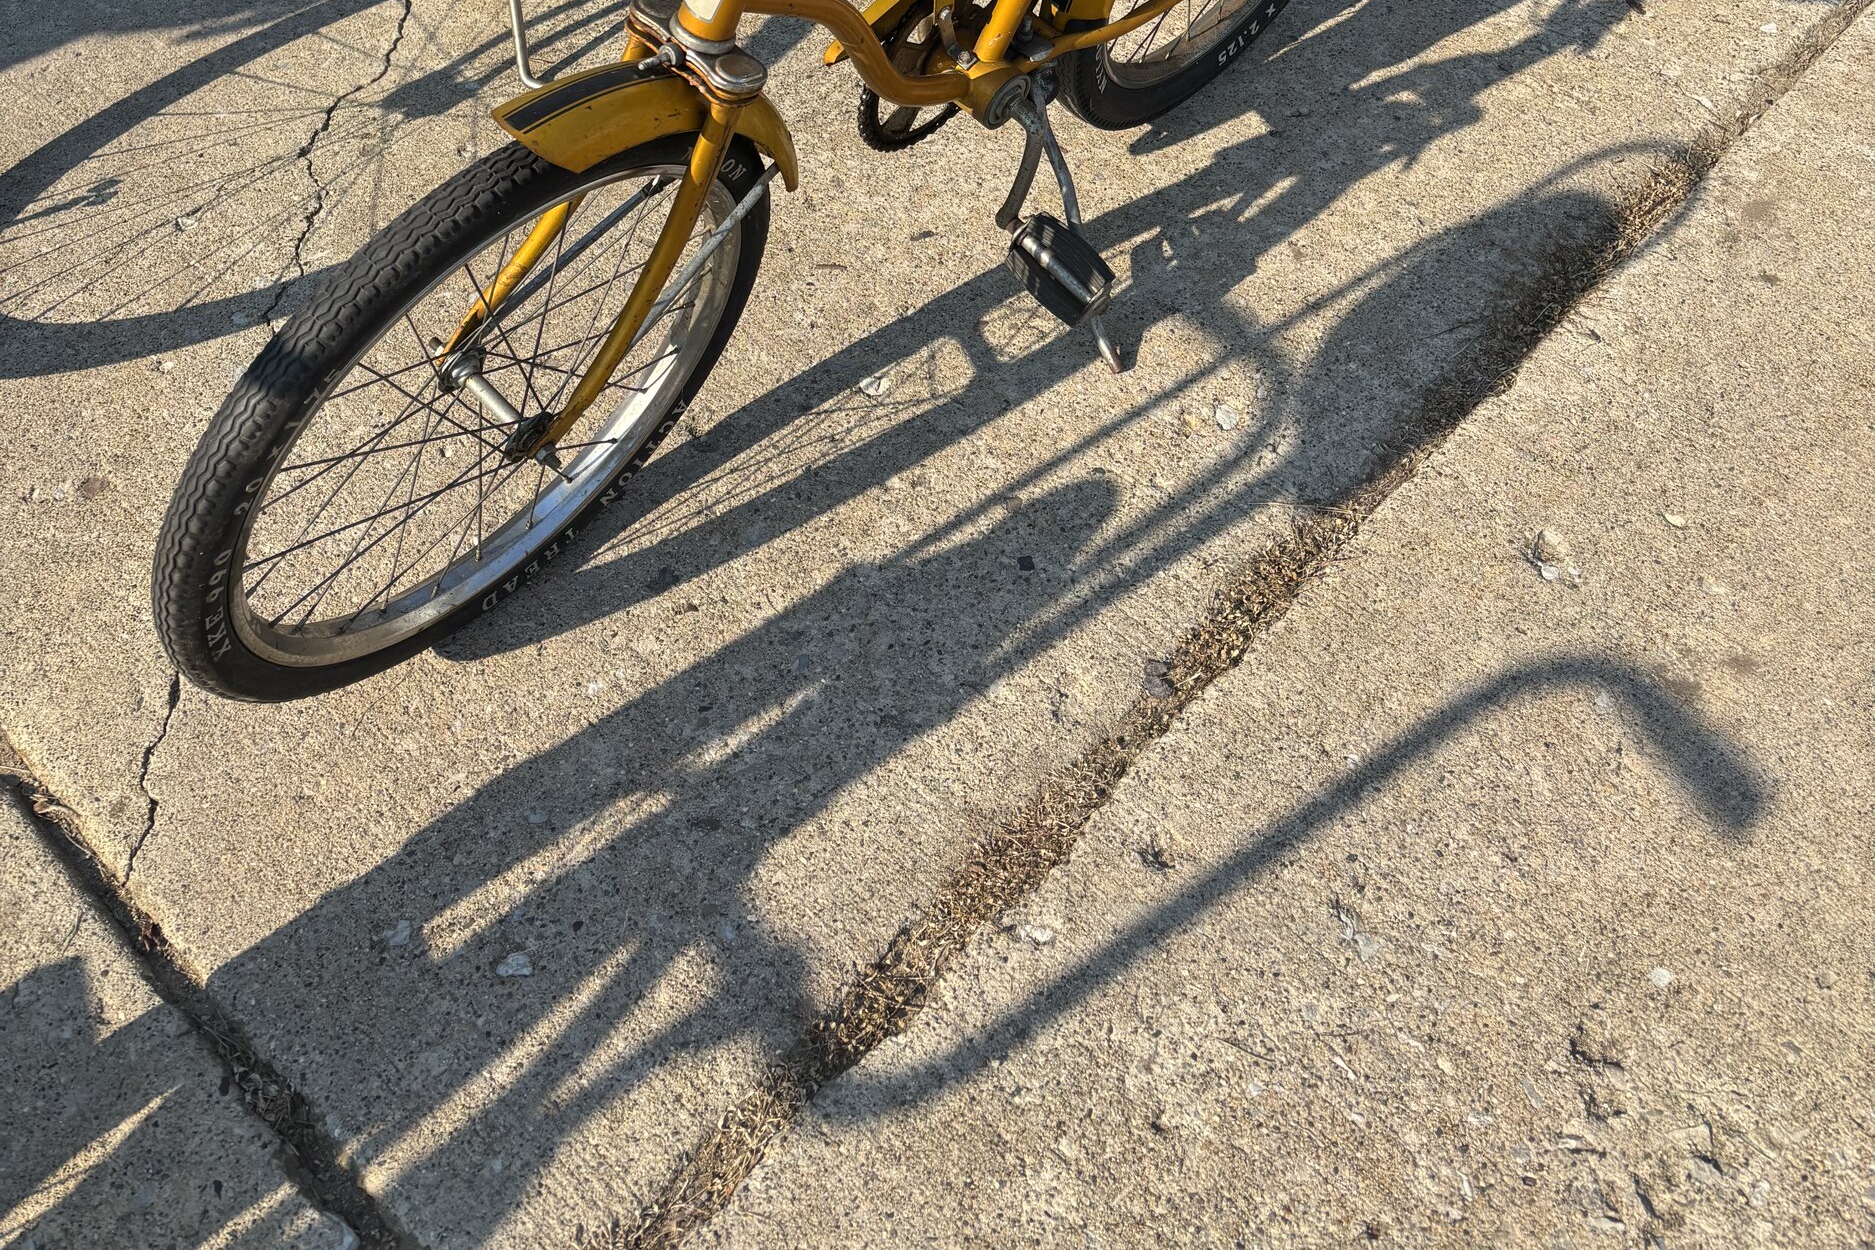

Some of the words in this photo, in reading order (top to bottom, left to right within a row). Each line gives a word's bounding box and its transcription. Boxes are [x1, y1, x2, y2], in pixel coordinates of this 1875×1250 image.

[1217, 19, 1261, 66] 2.125
[599, 402, 687, 508] ACTION
[233, 477, 263, 516] 20
[205, 549, 232, 603] 990
[481, 527, 580, 611] TREAD
[205, 609, 232, 663] XKE
